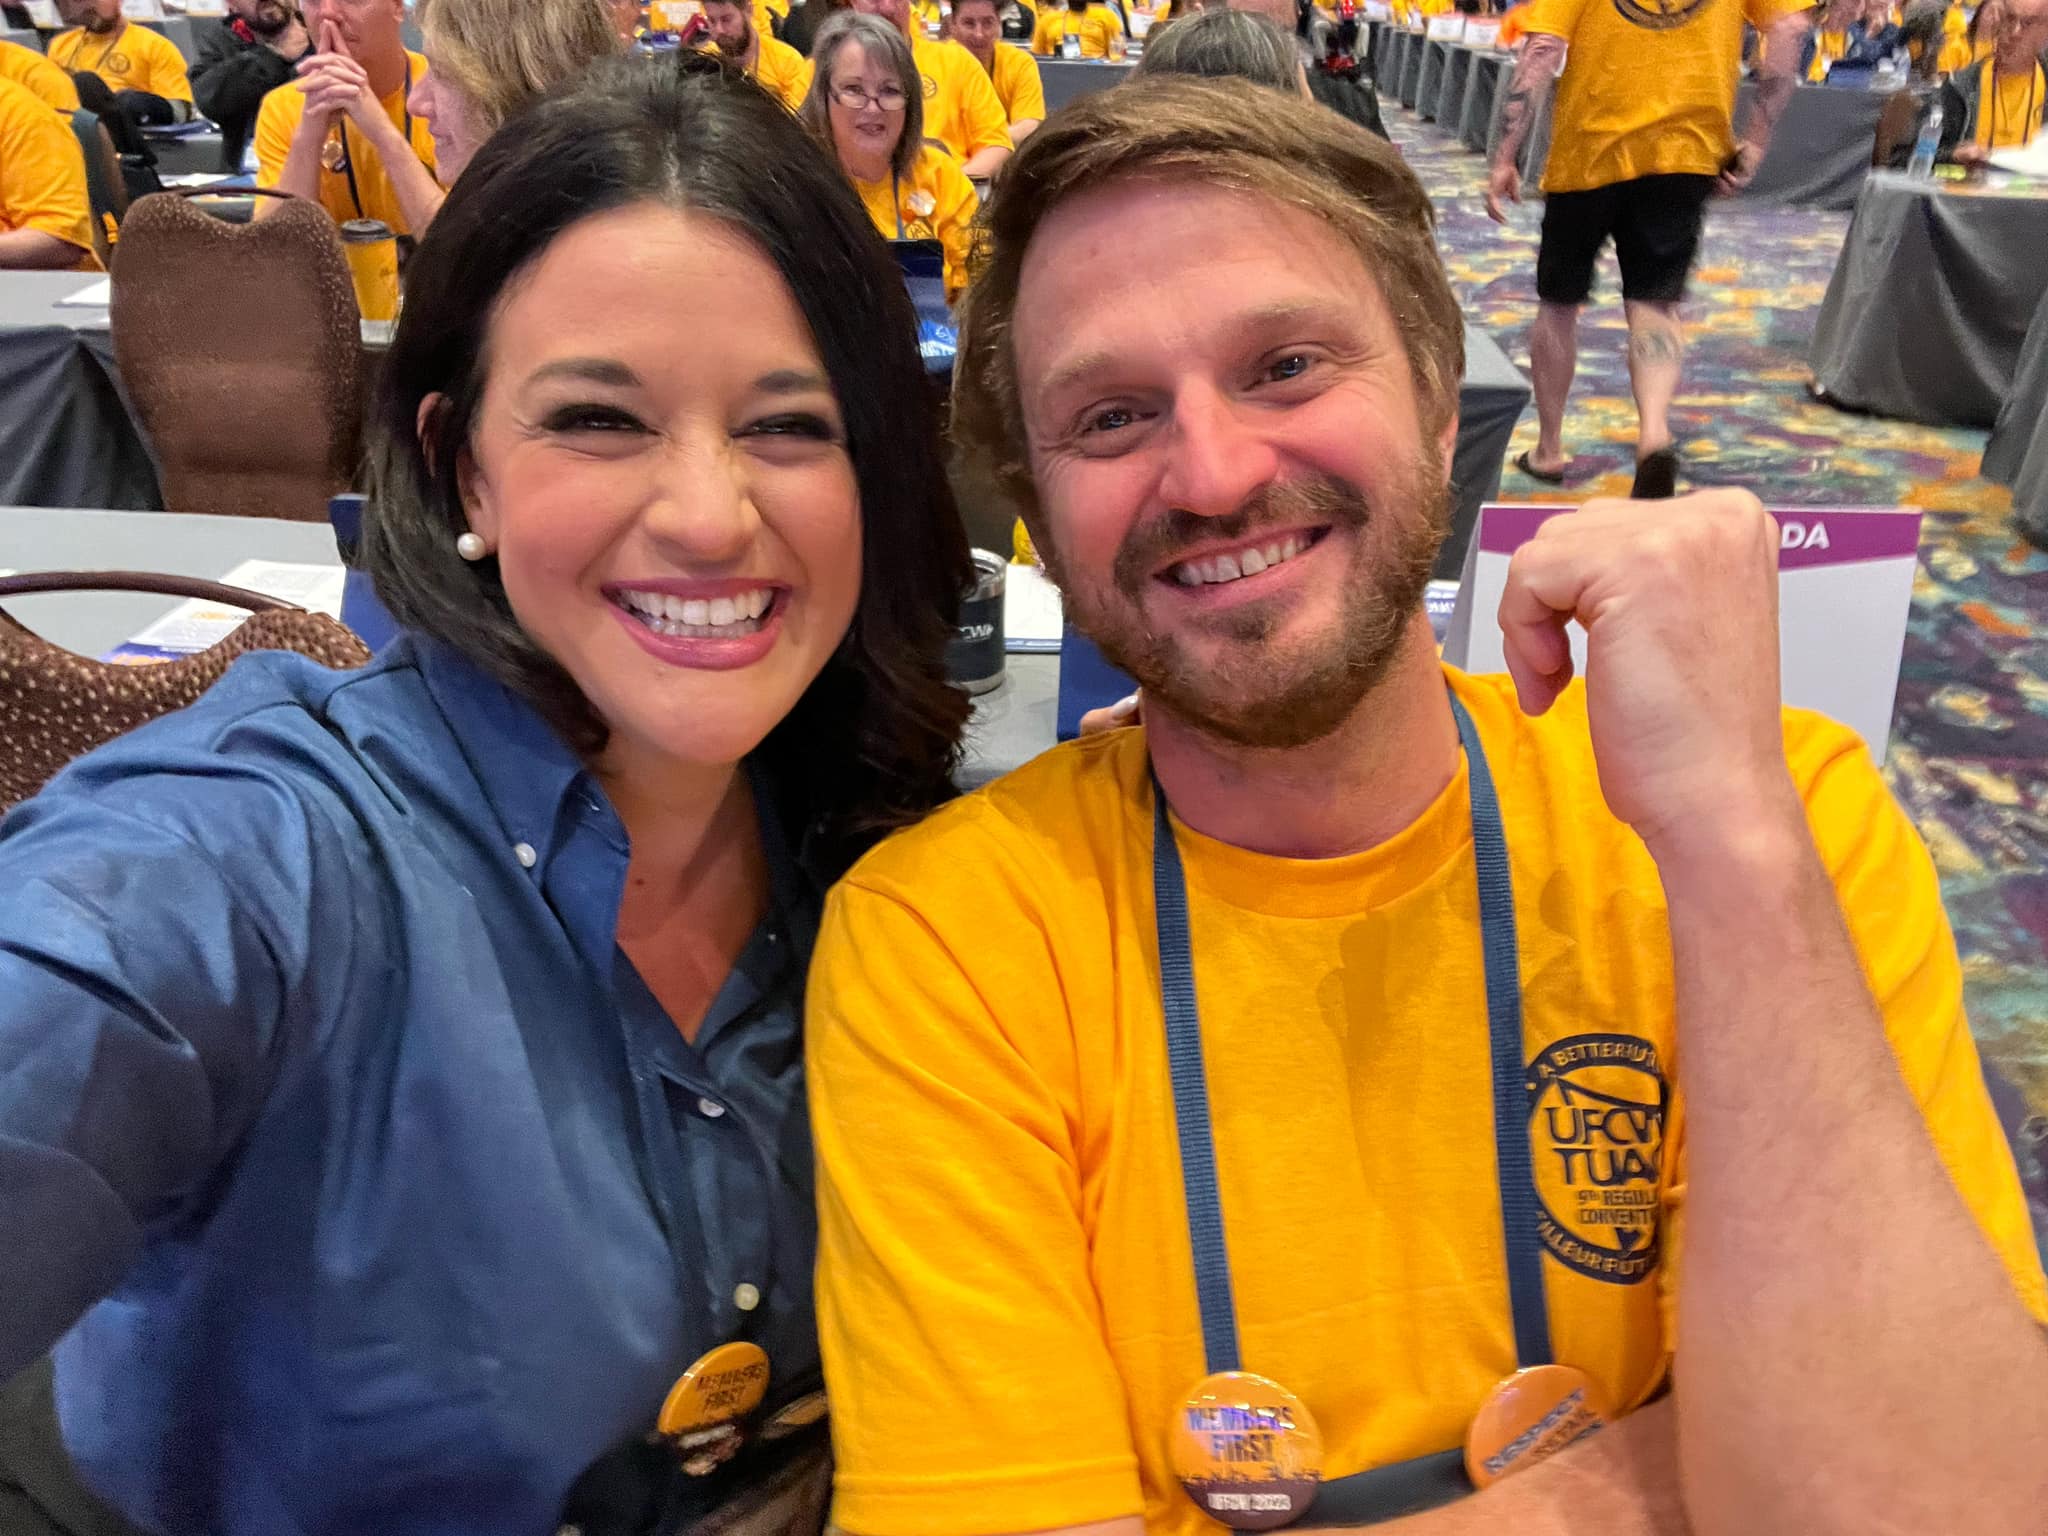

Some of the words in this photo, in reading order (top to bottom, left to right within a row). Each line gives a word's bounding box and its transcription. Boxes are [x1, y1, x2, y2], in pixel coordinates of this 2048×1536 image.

[1780, 521, 1830, 550] DA
[1552, 1149, 1661, 1186] TUA
[1603, 1189, 1657, 1206] REGUL
[1211, 1433, 1276, 1462] FIRST
